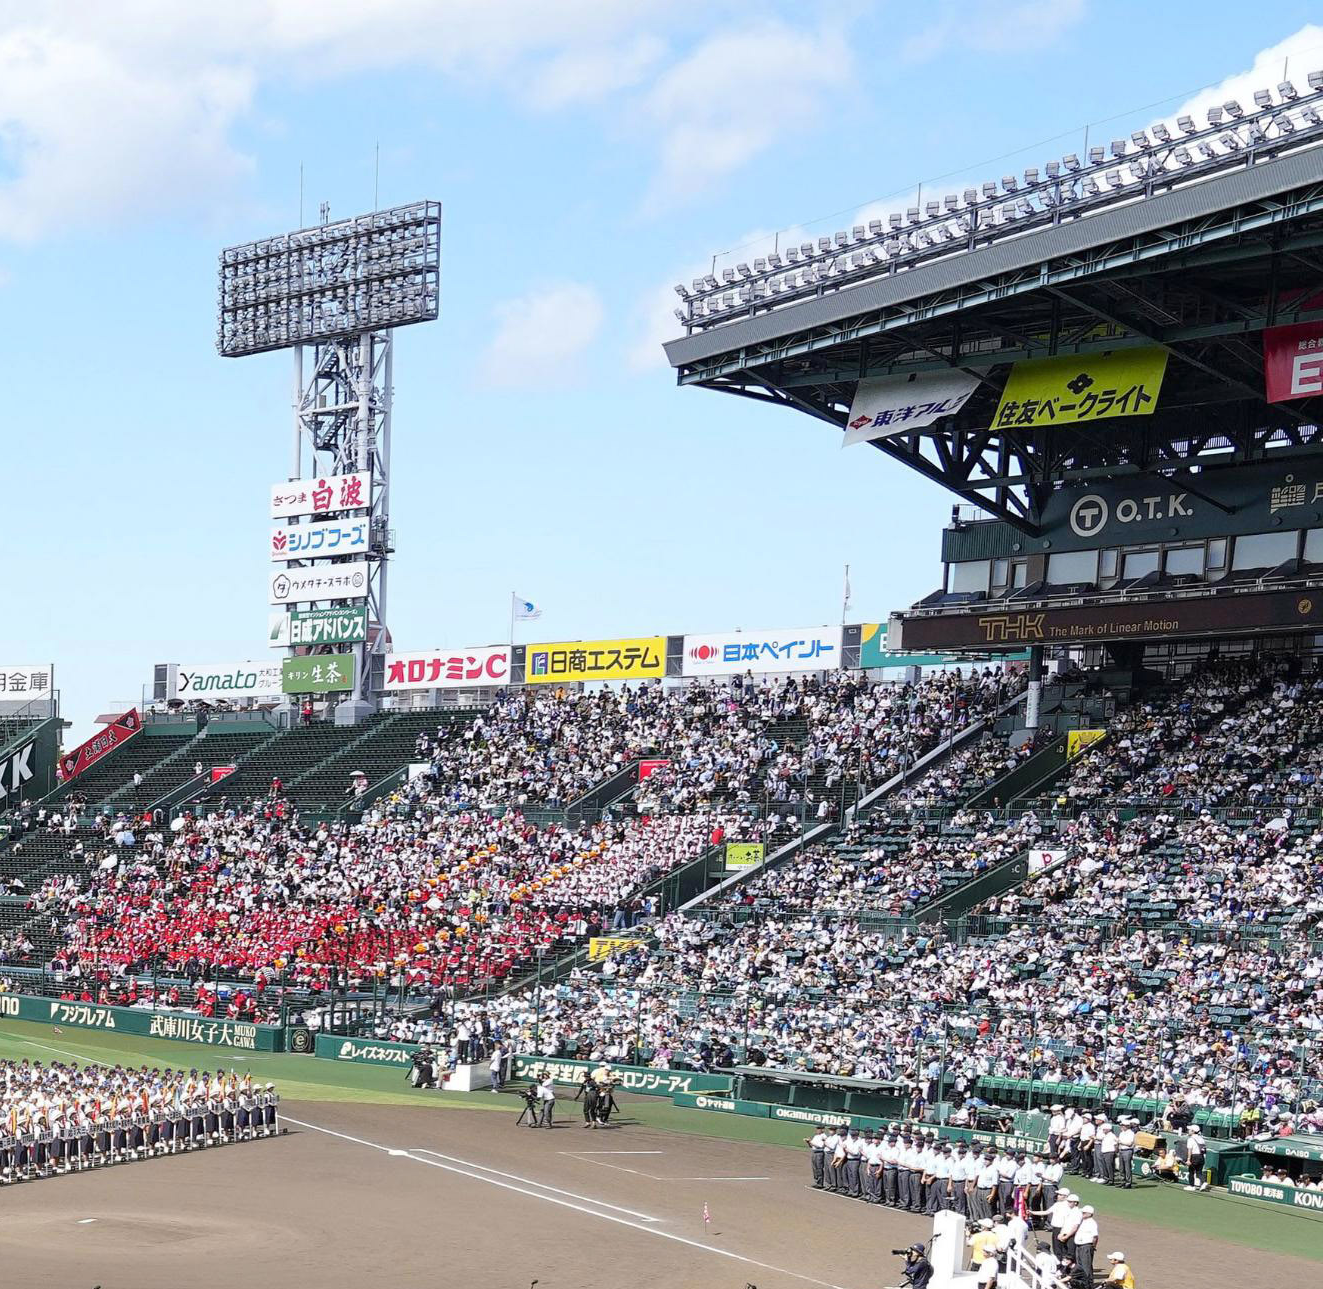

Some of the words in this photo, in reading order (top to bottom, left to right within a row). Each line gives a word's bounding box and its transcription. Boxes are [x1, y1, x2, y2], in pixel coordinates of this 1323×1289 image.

[997, 384, 1152, 427] 住友ベークライト
[273, 493, 307, 506] さつま
[312, 476, 364, 511] 白波
[1116, 493, 1193, 523] O.T.K.
[289, 524, 366, 552] シノブフーズ
[979, 613, 1045, 641] THK
[1050, 626, 1067, 637] The
[1070, 624, 1094, 636] Mark
[1097, 623, 1107, 634] of
[1110, 621, 1142, 633] Linear
[1144, 619, 1179, 631] Motion
[550, 647, 660, 674] 日商エステム
[723, 640, 834, 662] 日本ペイント
[288, 671, 309, 681] キリン
[311, 662, 342, 683] 生茶
[387, 653, 507, 684] オロナミンC
[178, 672, 257, 692] Yamato
[61, 1004, 115, 1028] フジプレアム
[149, 1015, 233, 1047] 武庫川女子大
[233, 1025, 256, 1037] MUKO
[233, 1036, 256, 1049] GAWA
[352, 1047, 409, 1062] レイズネクスト
[515, 1059, 589, 1084] ンボ学生服
[611, 1069, 693, 1092] キロンシーアイ
[1231, 1180, 1262, 1196] TOYOBO
